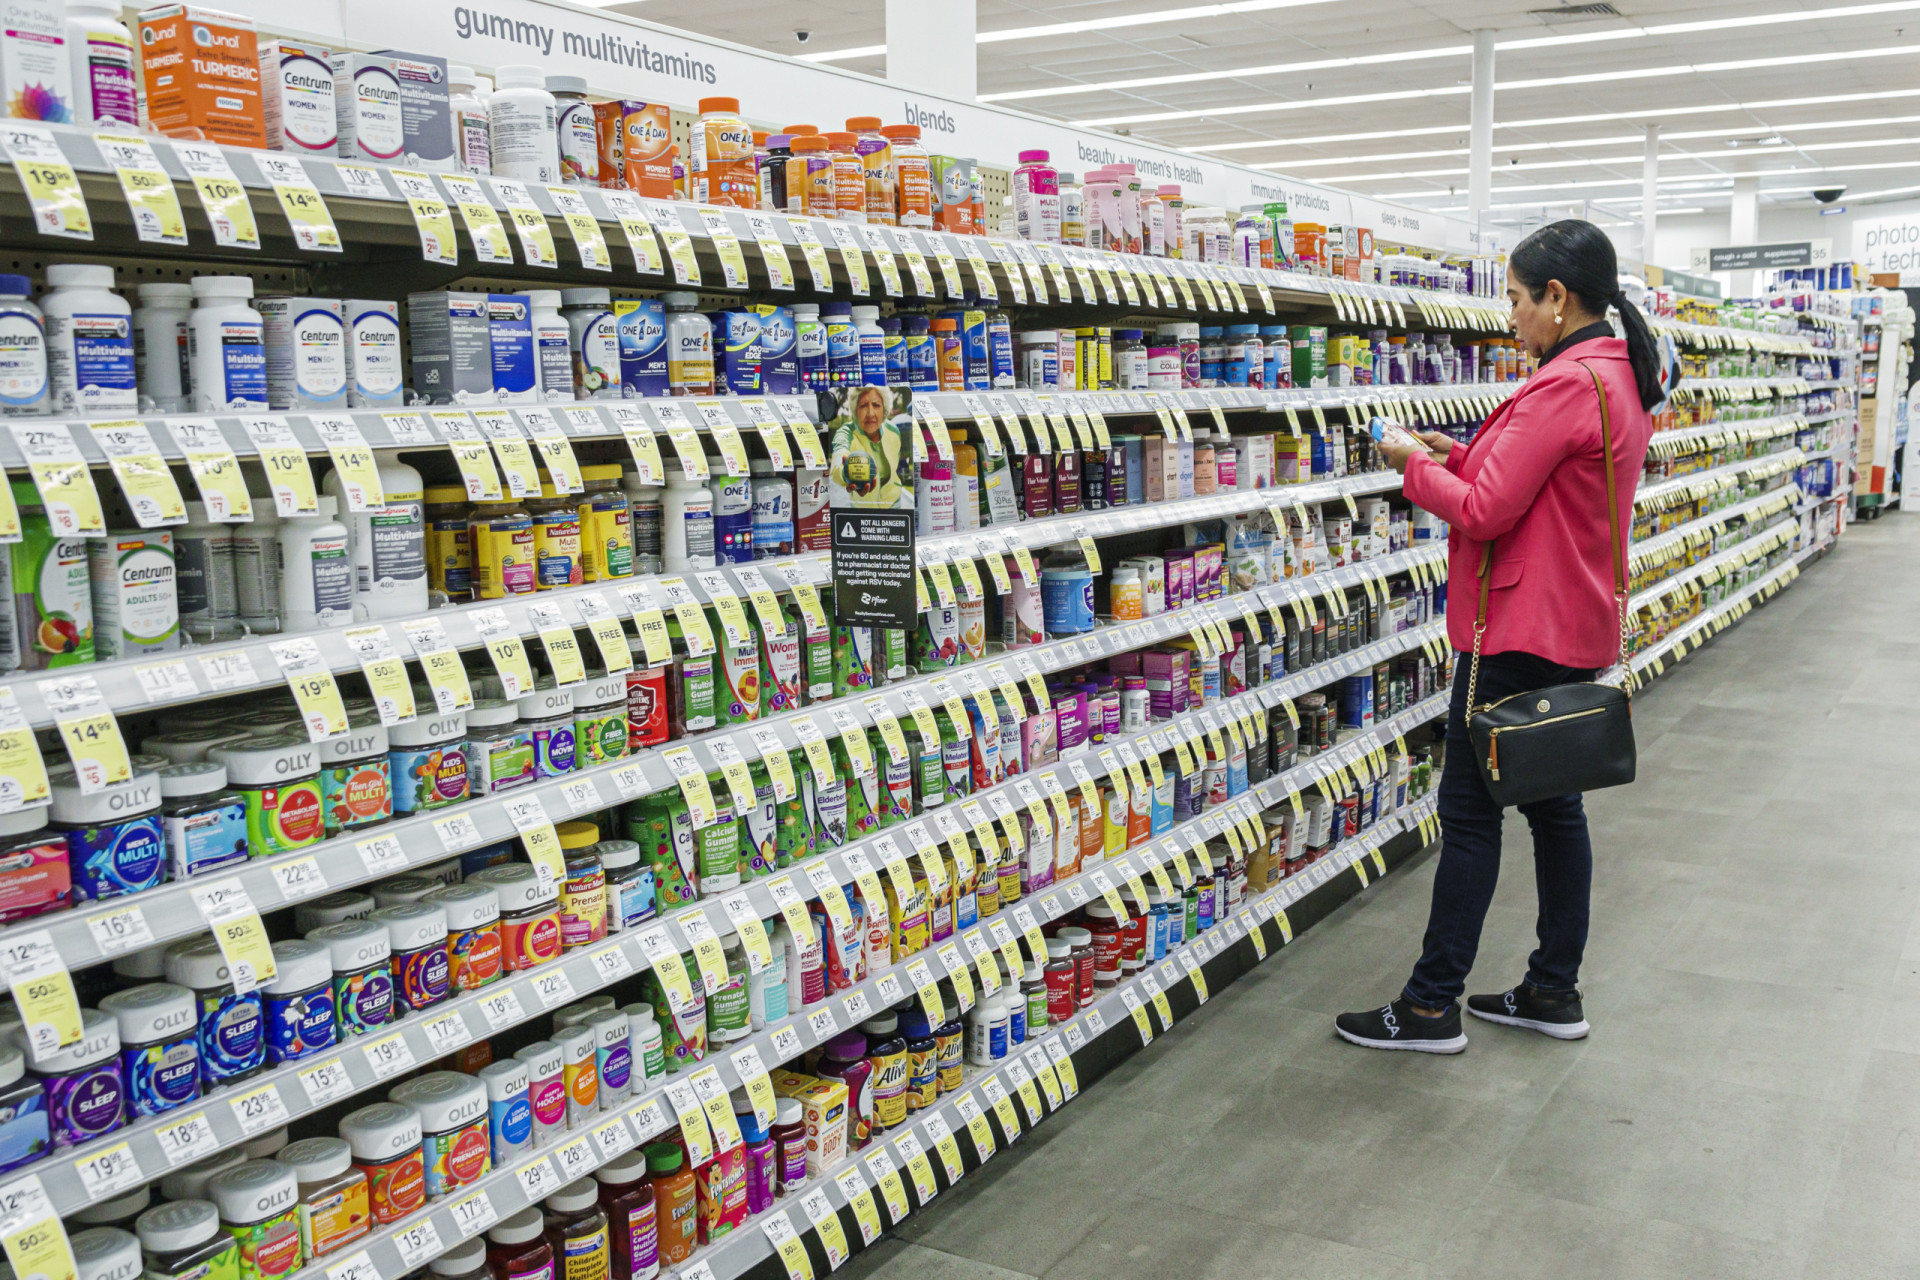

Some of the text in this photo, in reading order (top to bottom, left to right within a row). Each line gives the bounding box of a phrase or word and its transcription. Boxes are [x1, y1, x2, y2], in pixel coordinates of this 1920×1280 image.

[142, 25, 177, 46] Qunol
[192, 24, 240, 49] Qunol
[455, 6, 717, 84] gummy multivitamins
[145, 53, 184, 70] TURMERIC
[196, 50, 253, 66] Extra Strength
[192, 60, 259, 82] TURMERIC
[284, 72, 332, 91] Centrum
[358, 84, 399, 101] Centrum
[401, 88, 449, 102] Multivitamin
[288, 99, 317, 111] WOMEN
[361, 111, 386, 121] WOMEN
[904, 102, 955, 133] blends
[629, 125, 644, 136] ONE
[652, 129, 667, 140] DAY
[720, 132, 740, 143] ONE
[644, 164, 671, 174] WOMEN'S
[1077, 141, 1115, 165] beauty
[1127, 156, 1171, 178] women's
[1174, 162, 1203, 185] health
[1250, 180, 1286, 204] immunity
[1295, 192, 1330, 212] probiotics
[1381, 211, 1397, 228] sleep
[1403, 216, 1420, 230] stress
[1866, 222, 1919, 252] photo
[1714, 253, 1735, 262] cough
[1742, 251, 1757, 259] cold
[1764, 248, 1808, 259] supplements
[1813, 249, 1826, 259] 35
[1882, 251, 1920, 271] tech
[1694, 257, 1707, 266] 34
[76, 320, 116, 328] Walgreens
[622, 326, 637, 336] ONE
[647, 327, 662, 336] DAY
[301, 331, 339, 342] Centrum
[360, 331, 395, 342] Centrum
[491, 329, 531, 338] Multivitamin
[682, 337, 701, 347] ONE
[745, 351, 761, 359] EDGE
[648, 361, 666, 369] MEN'S
[724, 486, 743, 497] ONE
[559, 537, 576, 546] Multi
[842, 552, 859, 560] you're
[123, 565, 172, 582] Centrum
[855, 570, 877, 578] getting
[126, 593, 157, 606] ADULTS
[642, 621, 662, 632] FREE
[600, 629, 620, 640] FREE
[596, 682, 621, 698] OLLY
[545, 693, 570, 708] OLLY
[428, 718, 459, 736] OLLY
[605, 730, 622, 739] FIBER
[335, 737, 375, 755] OLLY
[275, 752, 312, 774] OLLY
[443, 757, 460, 767] KIDS
[438, 764, 465, 777] MULTI
[350, 777, 383, 791] Teen Girl
[110, 787, 152, 810] OLLY
[349, 788, 384, 803] MULTI
[281, 804, 319, 818] METABOLISM
[705, 825, 736, 837] Calcium
[126, 837, 149, 849] MEN'S
[118, 846, 157, 863] MULTI
[473, 902, 497, 920] OLLY
[418, 920, 444, 940] OLLY
[358, 942, 386, 961] OLLY
[469, 945, 501, 963] IMMUNITY
[427, 967, 448, 982] SLEEP
[713, 989, 745, 1002] Prenatal
[713, 996, 747, 1010] Gummies
[363, 995, 390, 1012] SLEEP
[232, 1008, 251, 1018] EXTRA
[303, 1010, 332, 1028] SLEEP
[311, 1007, 325, 1016] KIDS
[153, 1009, 189, 1031] OLLY
[225, 1020, 258, 1038] SLEEP
[605, 1025, 626, 1041] OLLY
[168, 1050, 188, 1060] EXTRA
[577, 1040, 594, 1058] OLLY
[161, 1063, 195, 1082] SLEEP
[539, 1058, 562, 1076] OLLY
[505, 1075, 528, 1094] OLLY
[578, 1074, 596, 1089] BLOAT
[79, 1091, 117, 1111] SLEEP
[536, 1091, 565, 1107] HOO-HA
[449, 1100, 481, 1122] OLLY
[507, 1110, 530, 1126] LIBIDO
[391, 1127, 418, 1147] OLLY
[452, 1145, 485, 1165] PRENATAL
[710, 1165, 745, 1200] FLINTSTONES
[257, 1188, 291, 1211] OLLY
[258, 1233, 298, 1257] PROBIOTIC
[568, 1253, 603, 1266] Children's
[569, 1261, 603, 1275] Complete
